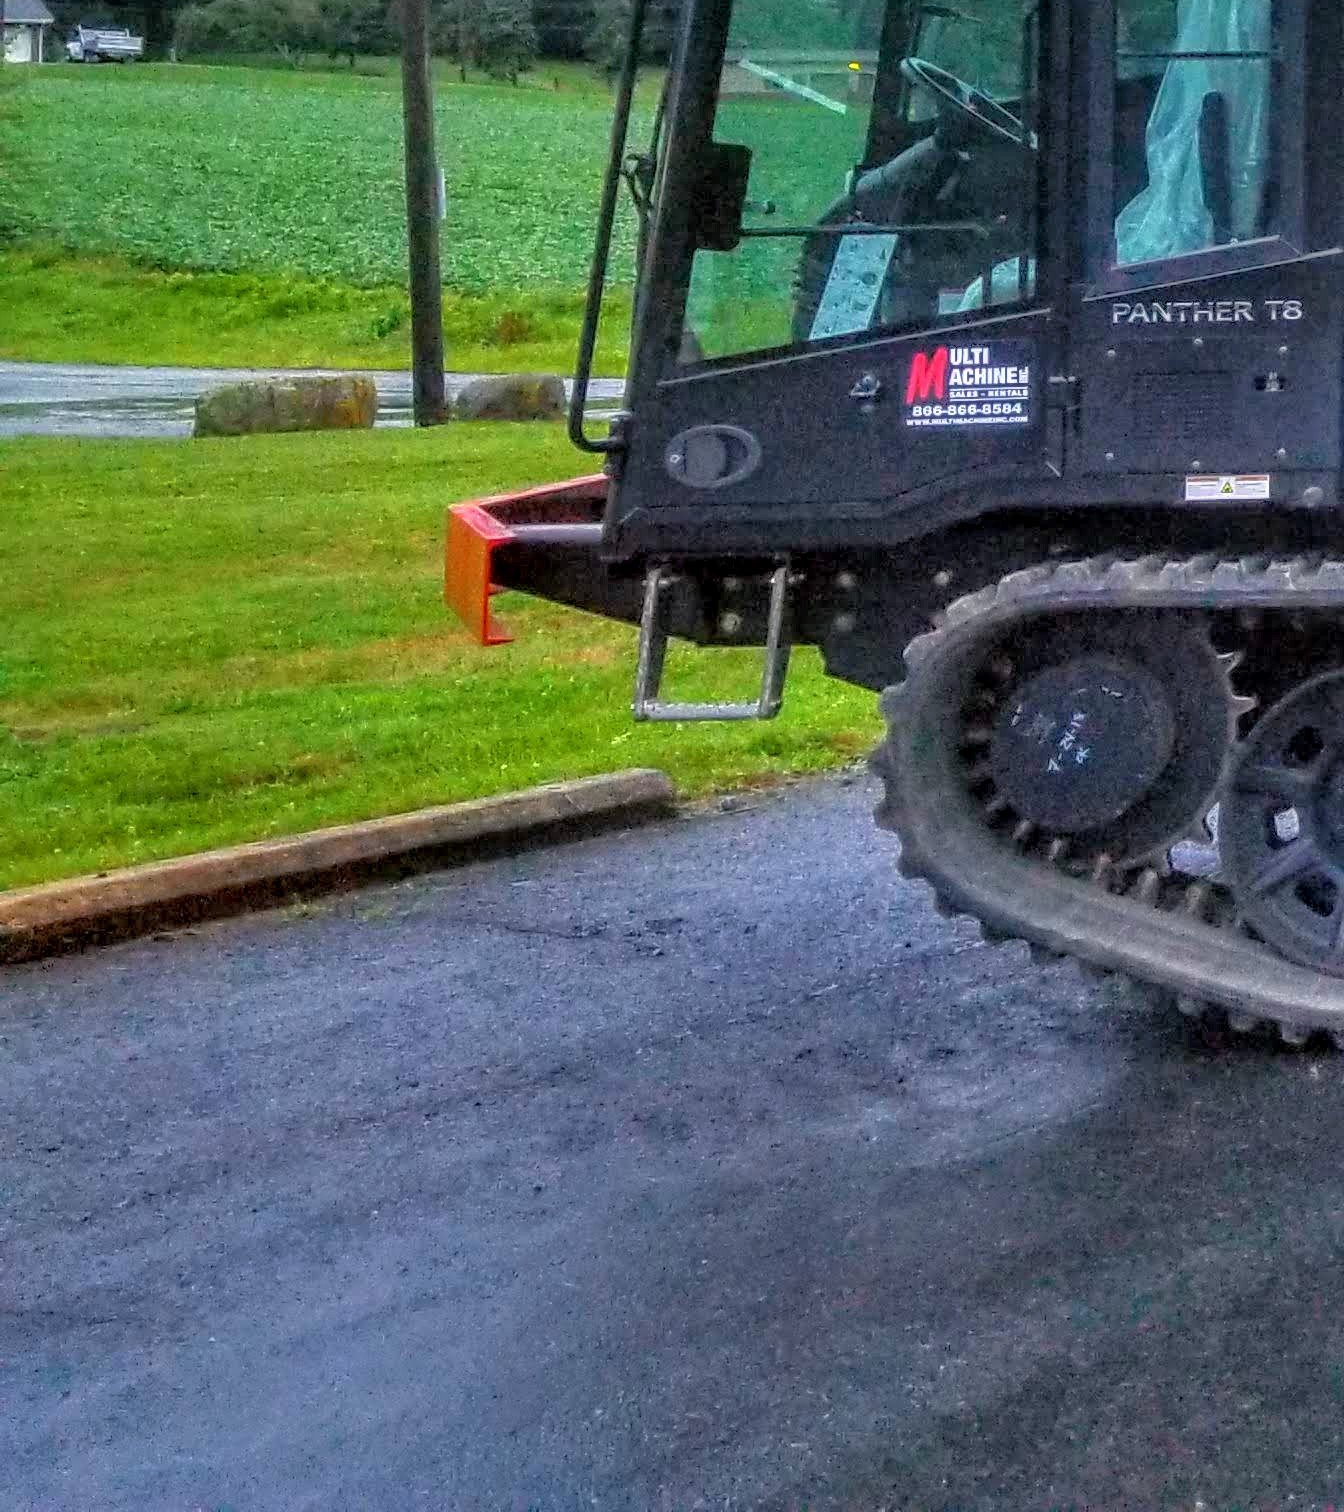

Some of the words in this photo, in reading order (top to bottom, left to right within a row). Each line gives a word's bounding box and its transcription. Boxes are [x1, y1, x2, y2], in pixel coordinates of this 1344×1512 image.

[1112, 301, 1254, 324] PANTHER
[1264, 300, 1303, 321] T8
[912, 403, 1021, 417] 866-866-8584
